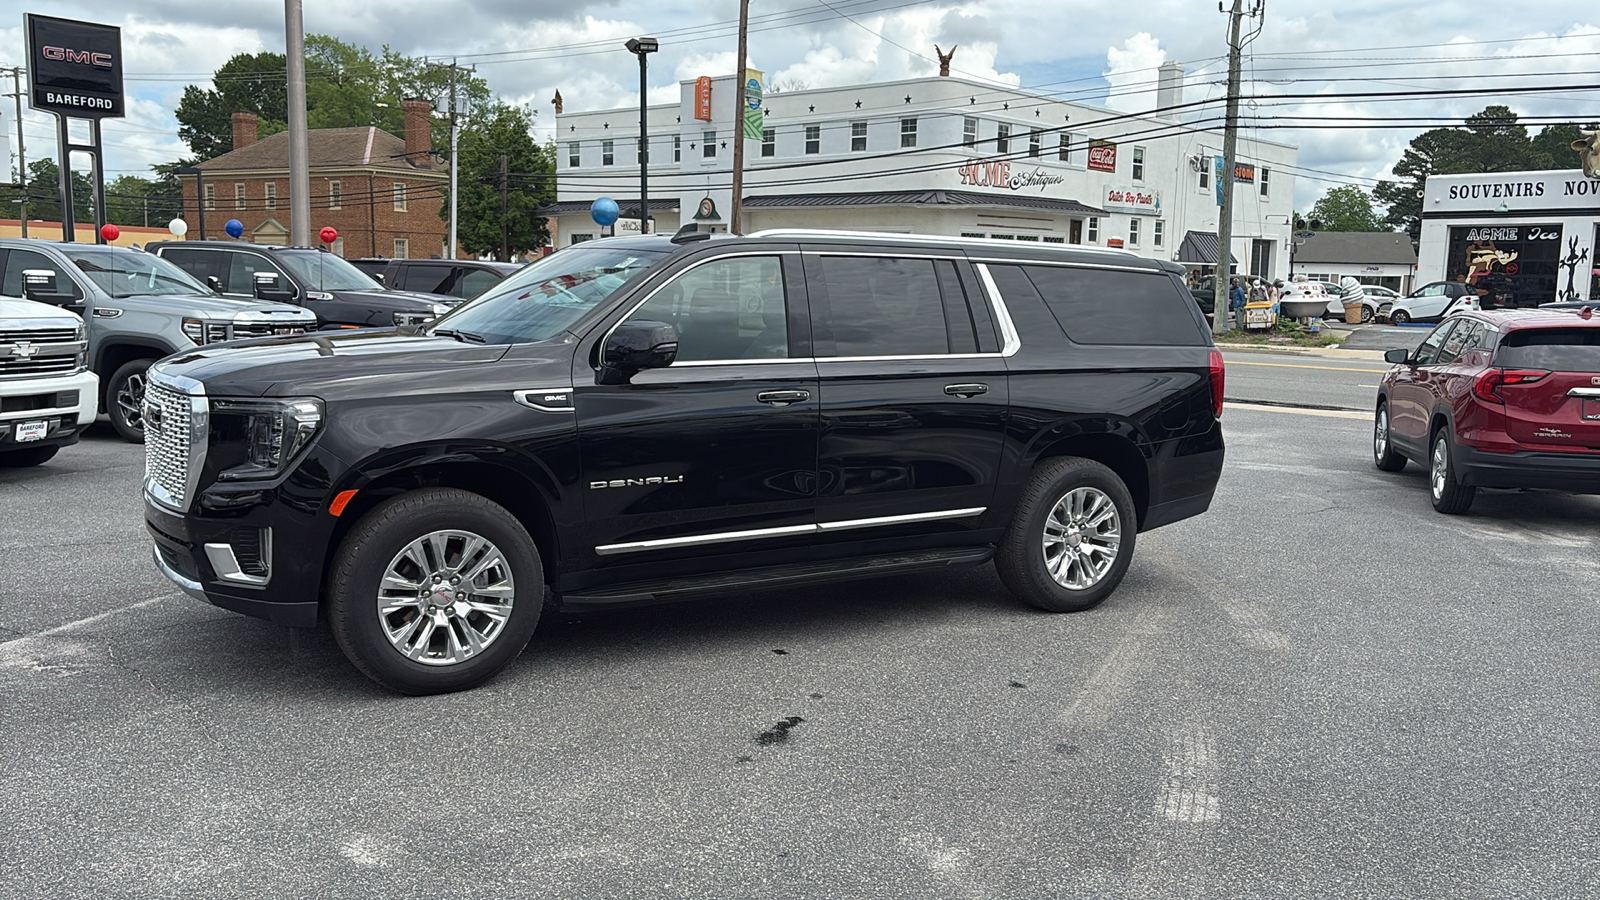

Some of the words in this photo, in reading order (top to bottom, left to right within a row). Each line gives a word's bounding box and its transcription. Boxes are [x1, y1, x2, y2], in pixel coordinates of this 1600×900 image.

[43, 46, 112, 67] GMC
[47, 93, 112, 109] BAREFORD
[959, 158, 1011, 189] ACME
[1010, 166, 1065, 192] Antiques
[1108, 190, 1124, 202] Dutch
[1125, 191, 1136, 206] Boy
[1136, 192, 1153, 205] Paints
[1449, 182, 1545, 200] SOUVENIRS
[1466, 228, 1518, 241] ACME
[1527, 227, 1560, 241] Ice
[590, 475, 684, 490] DENALI
